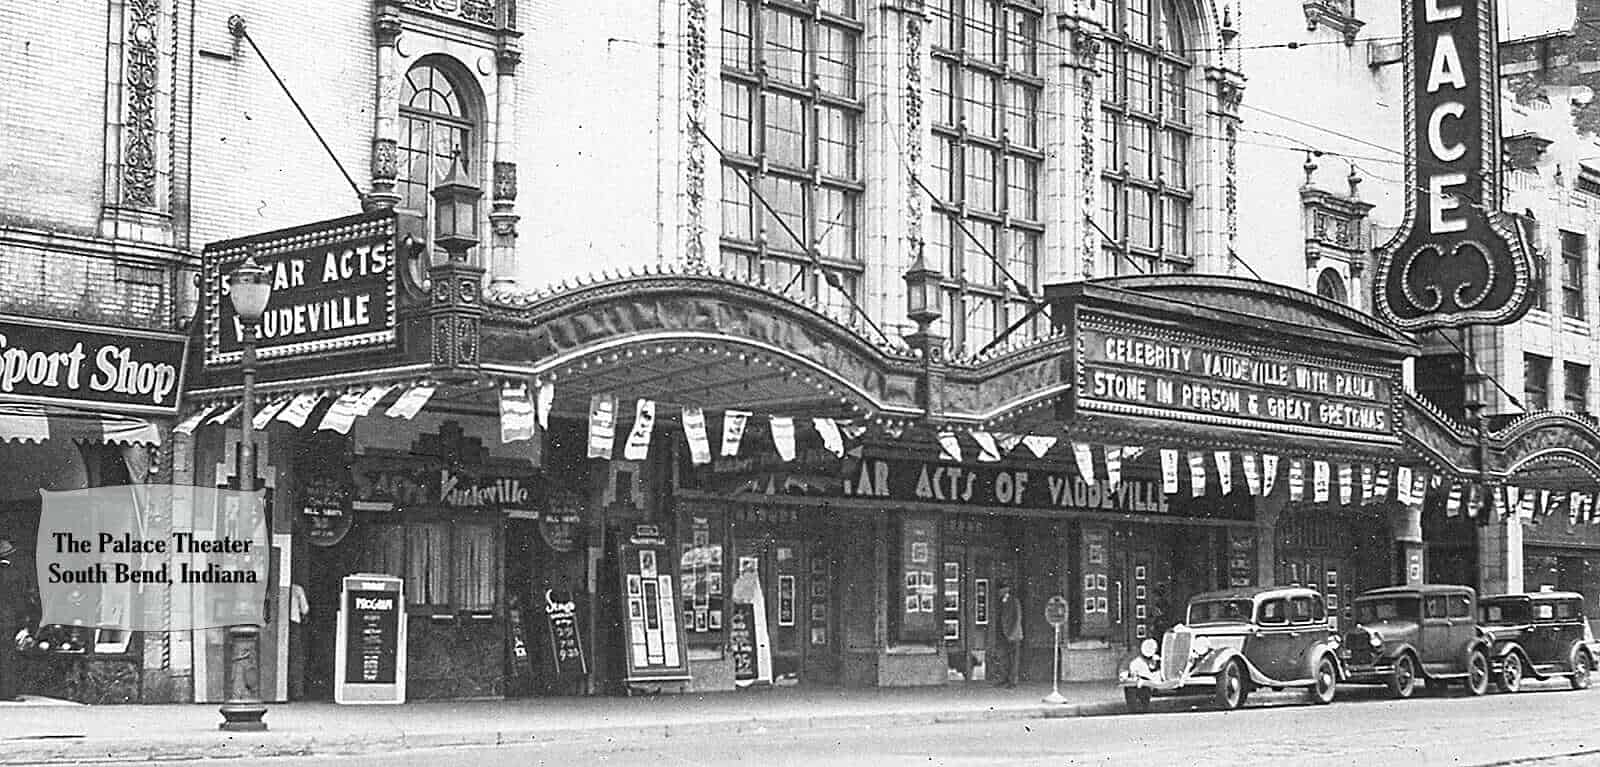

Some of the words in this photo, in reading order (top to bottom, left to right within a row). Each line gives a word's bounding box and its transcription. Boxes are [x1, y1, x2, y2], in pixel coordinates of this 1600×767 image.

[322, 245, 386, 282] ACTS
[90, 345, 175, 404] Shop
[1105, 338, 1192, 371] CELEBRITY
[1202, 353, 1288, 386] VAUDEVILLE
[1296, 367, 1328, 392] WITH
[1336, 374, 1375, 400] PAULA
[1094, 372, 1146, 400] STONE
[1157, 379, 1173, 404] IN
[1182, 384, 1240, 413] PERSON
[1248, 394, 1259, 416] &
[1267, 398, 1311, 421] GREAT
[441, 469, 528, 505] Vaudeville
[916, 464, 976, 500] ACTS
[995, 472, 1028, 504] OF
[1048, 475, 1168, 513] VAUDEVILLE
